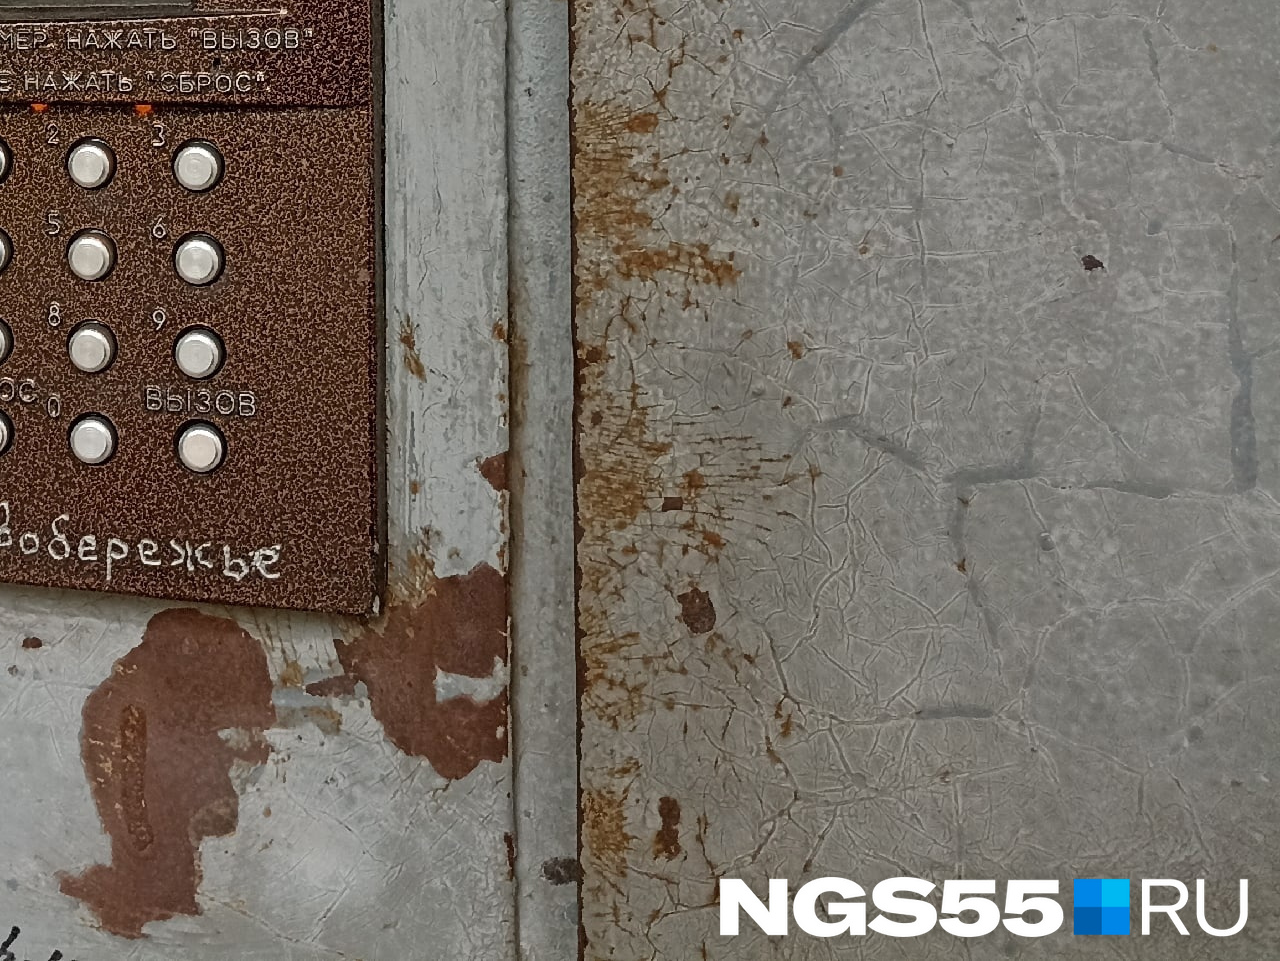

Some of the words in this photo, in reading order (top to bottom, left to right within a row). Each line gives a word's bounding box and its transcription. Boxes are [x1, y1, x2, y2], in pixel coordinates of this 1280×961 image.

[67, 28, 177, 50] НАЖАТЬ
[190, 28, 313, 50] "ВЫЗОВ"
[24, 71, 134, 92] НАЖАТЬ
[145, 70, 266, 93] "СБРОС"
[46, 124, 59, 145] 2
[152, 124, 166, 147] 3
[46, 213, 61, 235] 5
[152, 217, 167, 239] 6
[47, 302, 61, 327] 8
[152, 309, 167, 331] 9
[145, 386, 257, 417] ВЫЗОВ
